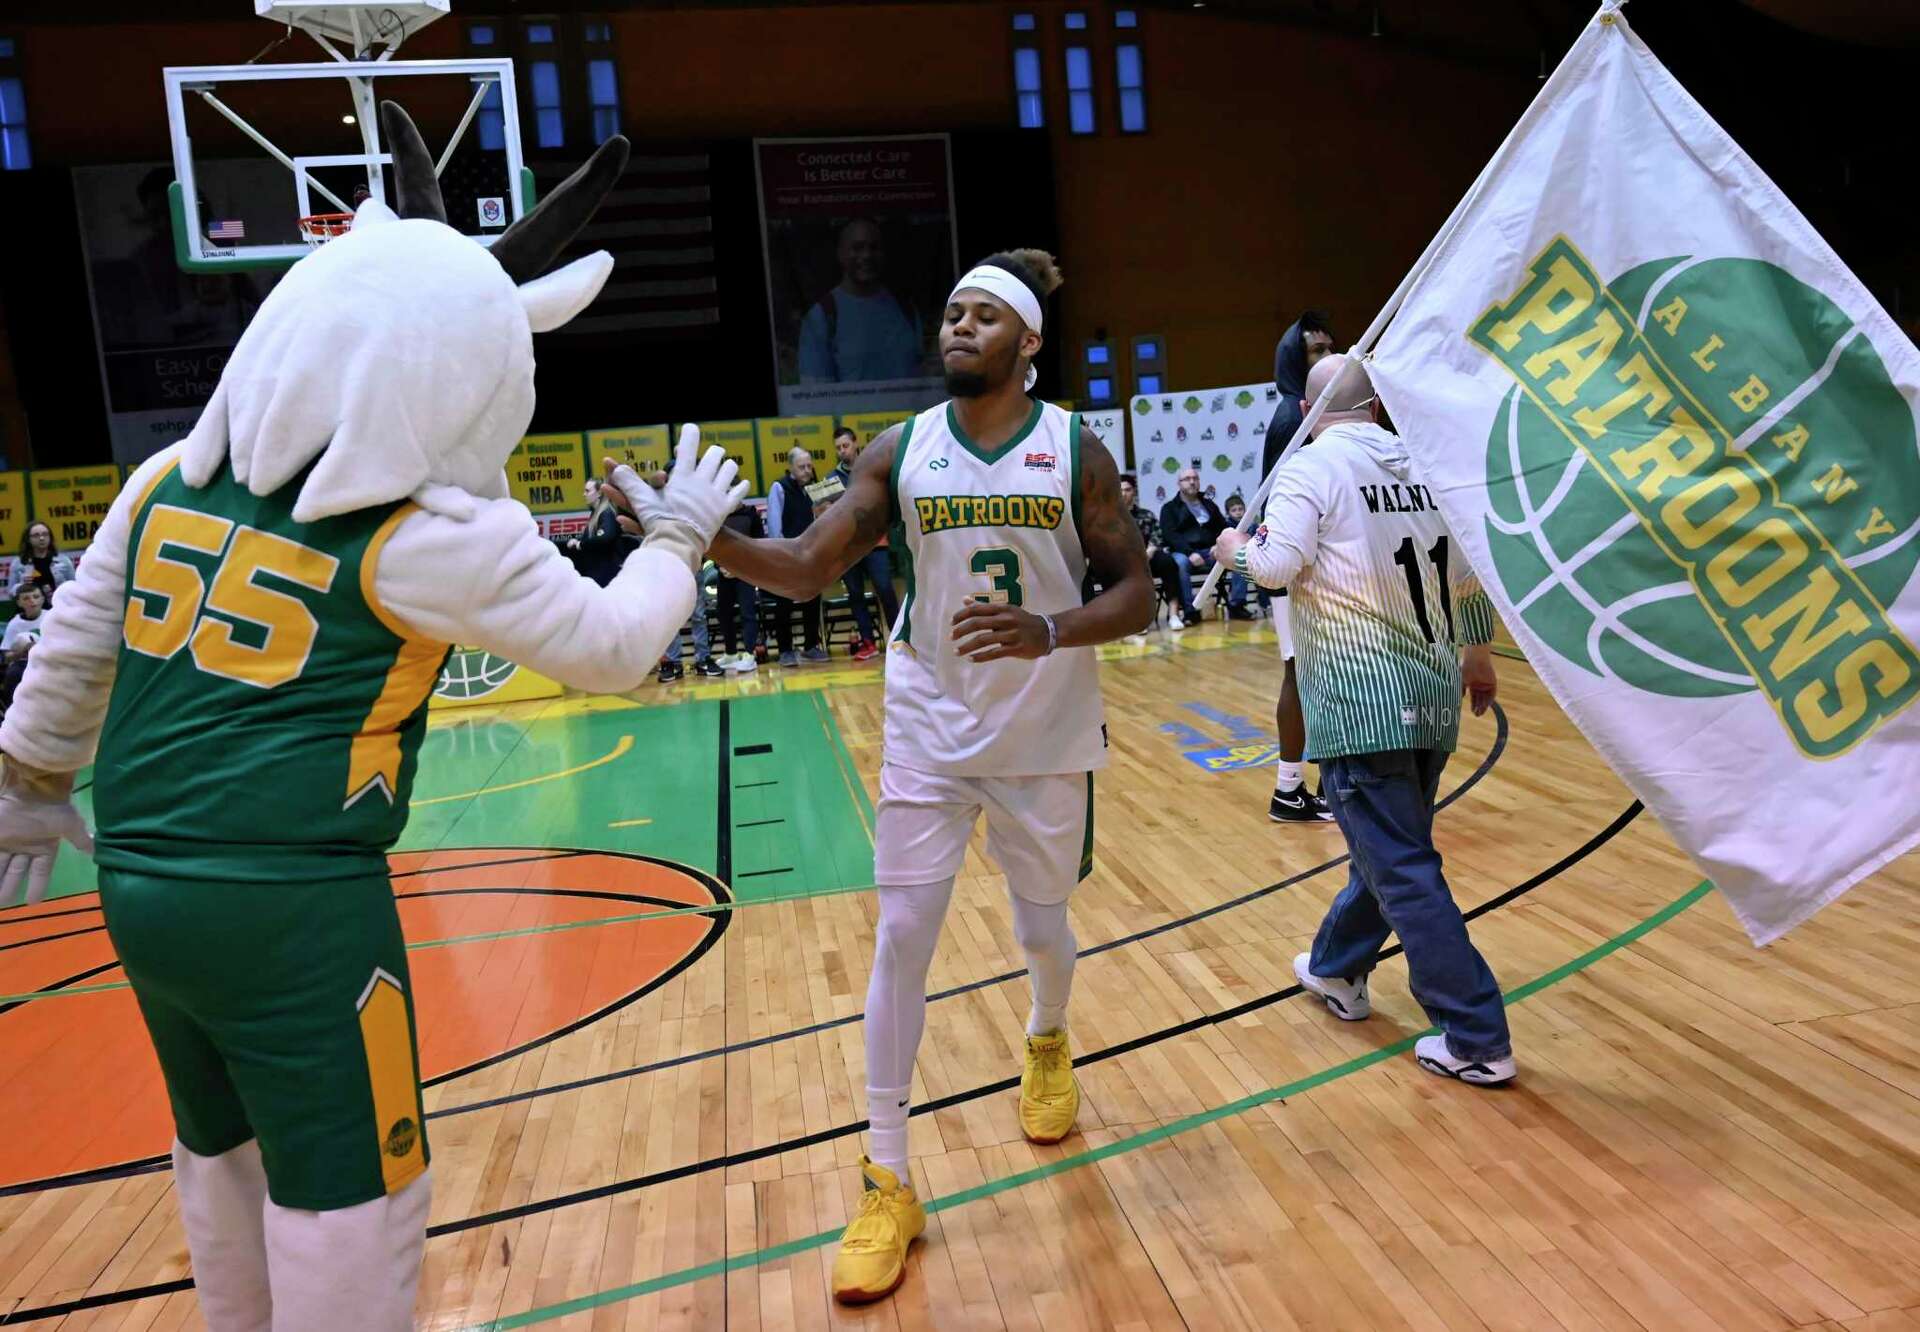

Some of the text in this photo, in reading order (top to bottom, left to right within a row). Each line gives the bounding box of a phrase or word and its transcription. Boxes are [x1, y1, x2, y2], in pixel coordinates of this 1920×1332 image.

[799, 149, 912, 166] Connected Care
[820, 167, 867, 181] Better
[872, 165, 908, 180] Care
[154, 357, 201, 378] Easy
[161, 376, 210, 399] Sche
[1652, 296, 1896, 545] ALBANY
[529, 455, 558, 468] COACH
[517, 467, 573, 483] 1987-1988
[529, 486, 565, 505] NBA
[1480, 248, 1915, 748] PATROONS
[914, 495, 1065, 535] PATROONS
[63, 521, 102, 542] NBA
[968, 545, 1026, 610] 3
[123, 503, 341, 689] 55
[1393, 535, 1455, 644] 11
